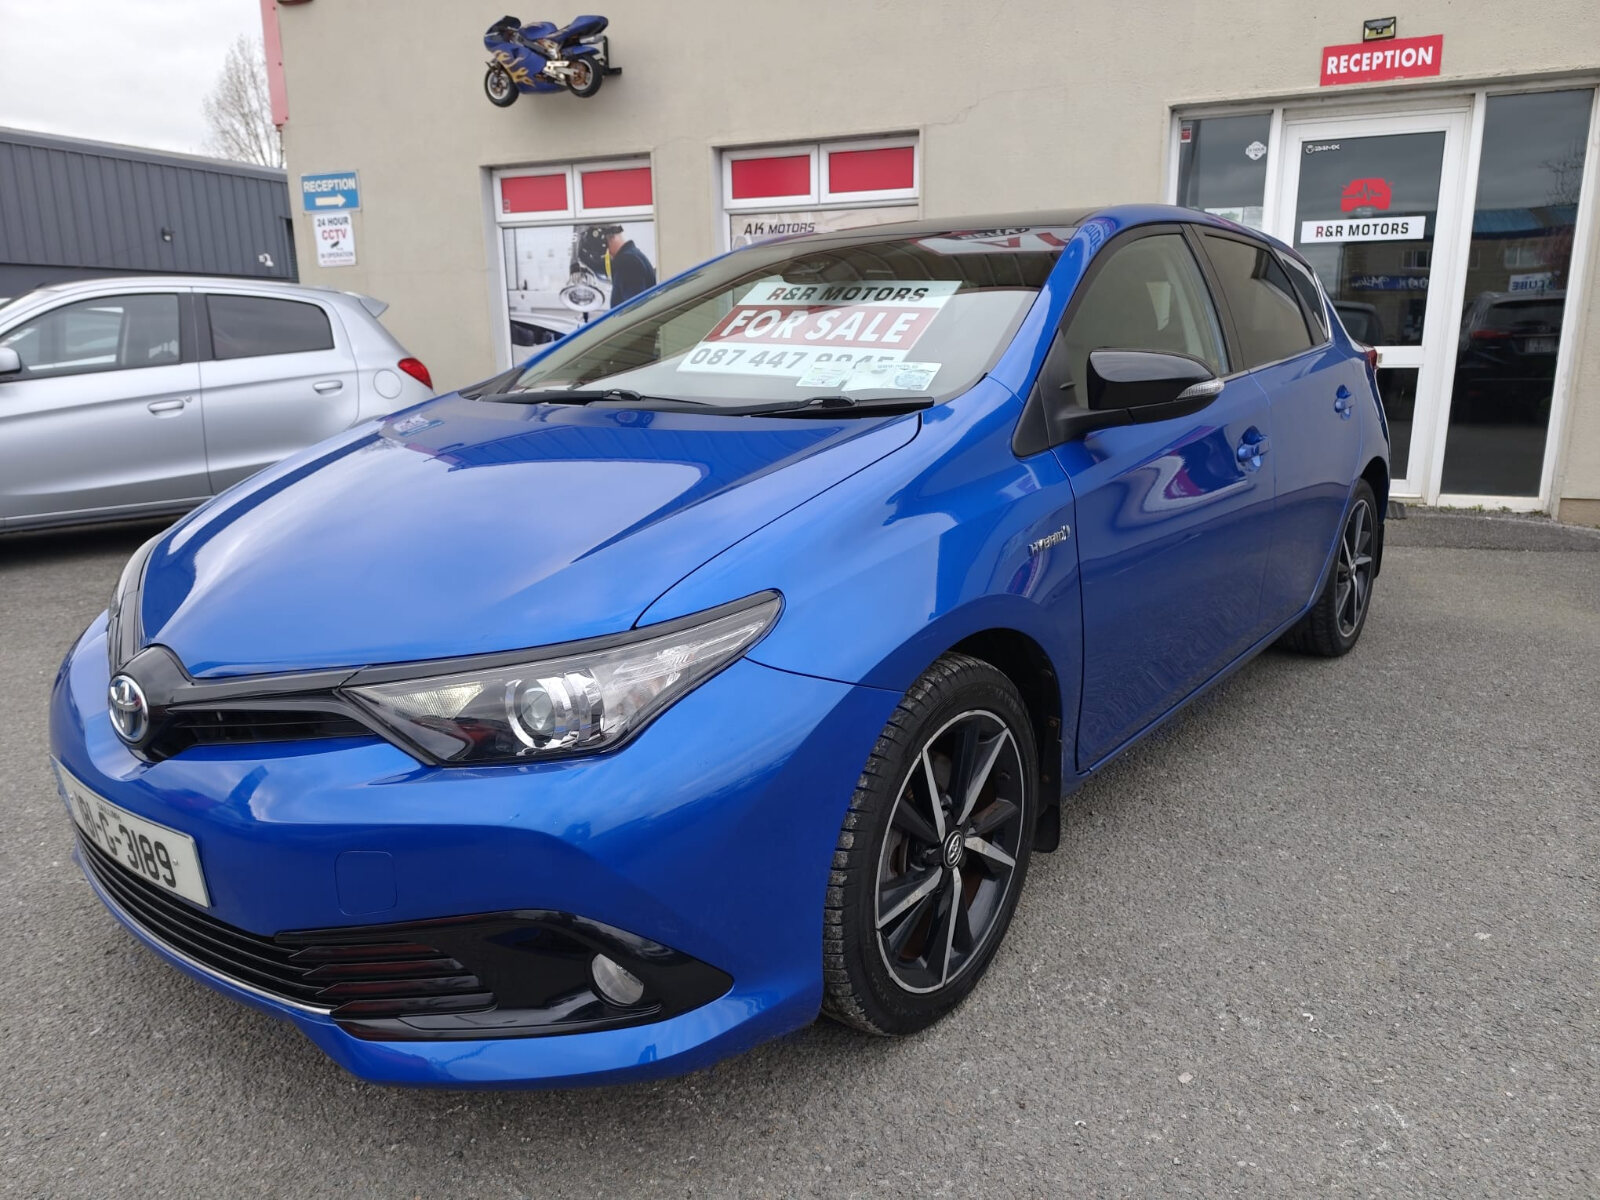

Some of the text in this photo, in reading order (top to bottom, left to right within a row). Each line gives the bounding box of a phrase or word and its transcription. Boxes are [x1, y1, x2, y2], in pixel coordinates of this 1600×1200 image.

[1326, 45, 1433, 75] RECEPTION
[303, 178, 356, 193] RECEPTION
[317, 216, 350, 228] 24 HOUR
[768, 222, 816, 234] MOTORS
[1315, 222, 1410, 237] R&R MOTORS
[322, 229, 347, 241] CCTV
[766, 286, 929, 303] R&R MOTORS
[720, 309, 920, 343] FOR SALE
[689, 348, 746, 366] 087
[748, 350, 808, 369] 447
[1028, 526, 1068, 555] HYBRID
[73, 790, 177, 888] 181-G-3189
